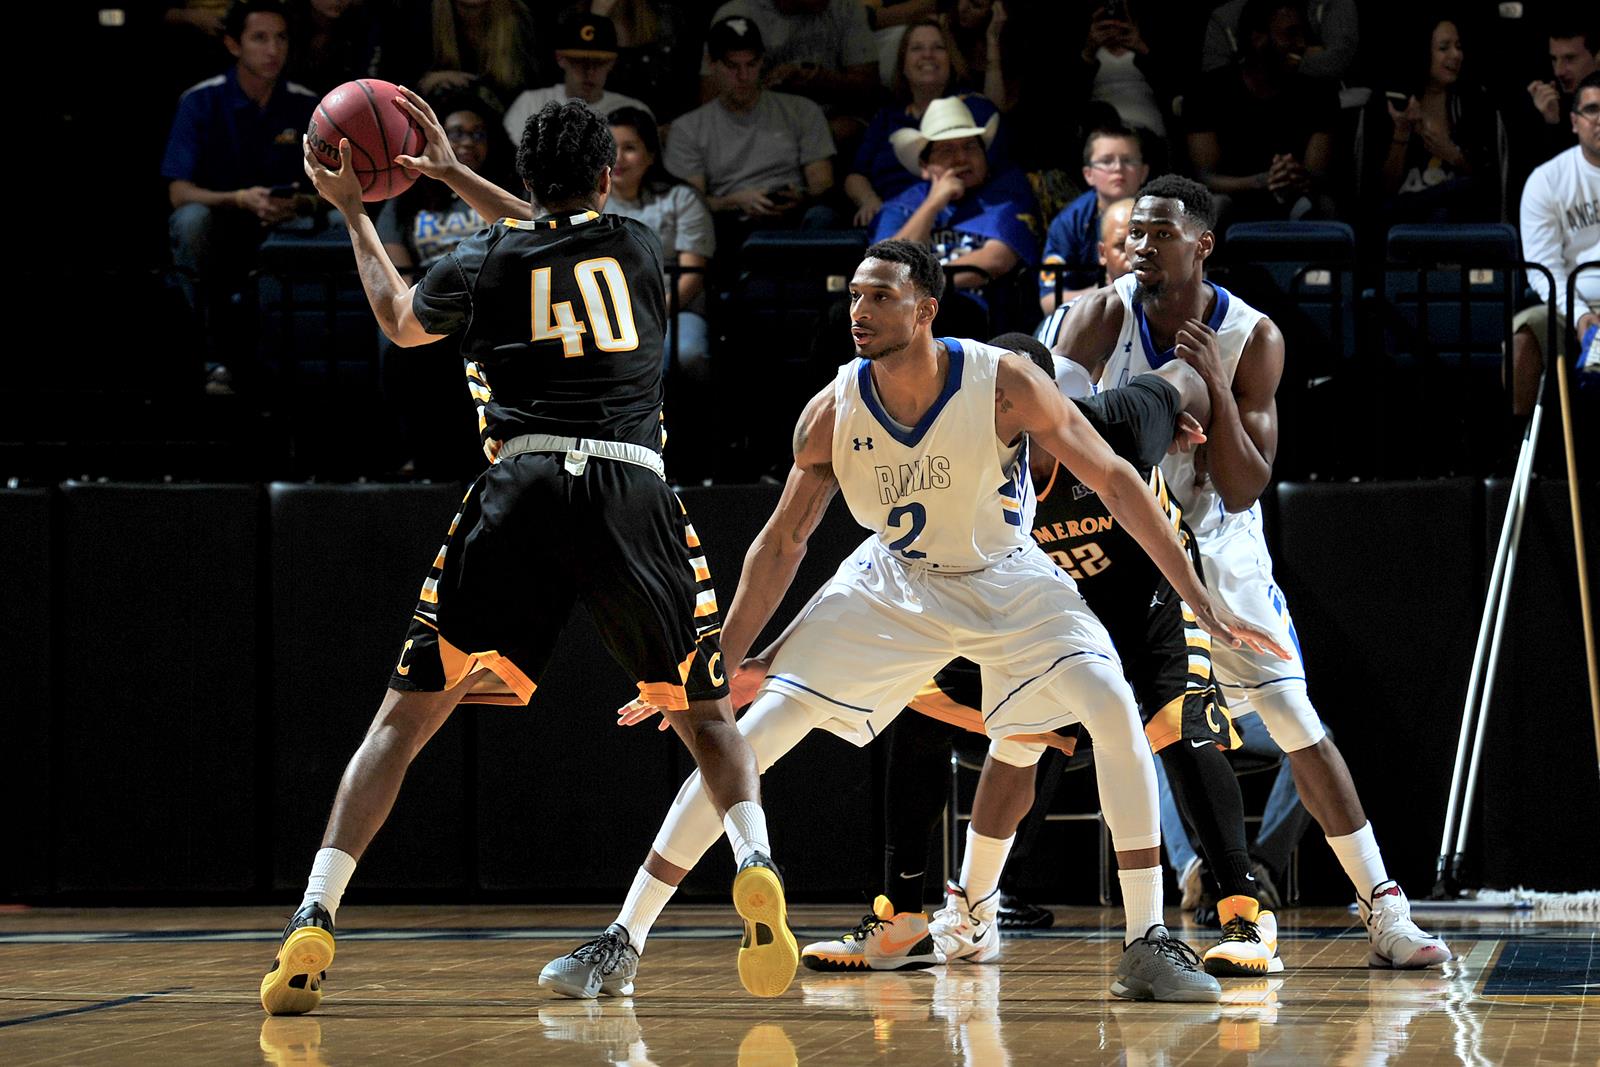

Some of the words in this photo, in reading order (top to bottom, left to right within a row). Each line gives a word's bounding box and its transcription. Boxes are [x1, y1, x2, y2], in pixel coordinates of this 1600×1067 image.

[530, 256, 639, 358] 40
[888, 502, 926, 558] 2
[1047, 542, 1112, 579] 22
[397, 639, 414, 675] C
[708, 651, 724, 687] C
[1205, 702, 1220, 733] C
